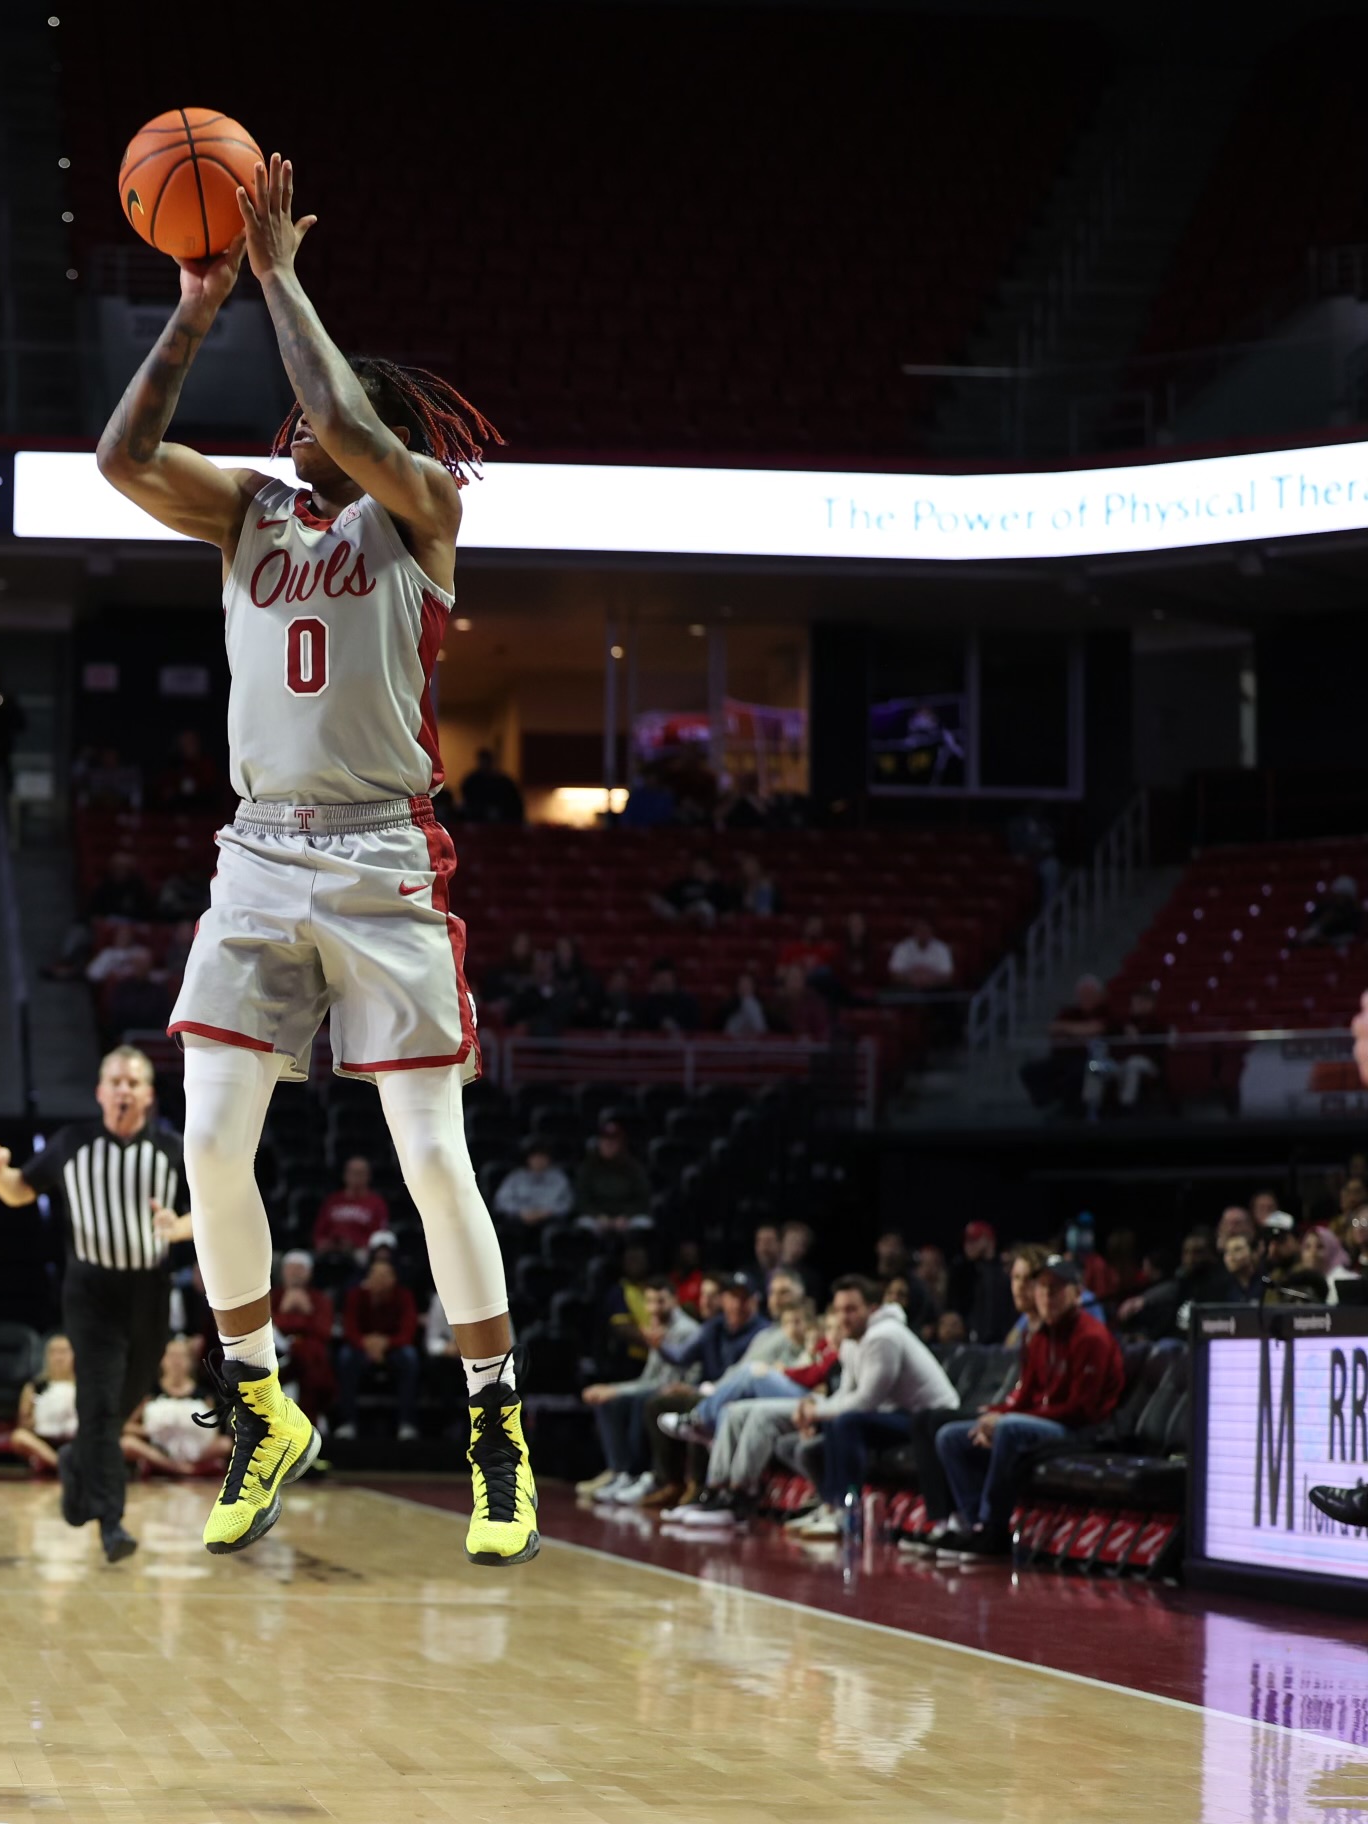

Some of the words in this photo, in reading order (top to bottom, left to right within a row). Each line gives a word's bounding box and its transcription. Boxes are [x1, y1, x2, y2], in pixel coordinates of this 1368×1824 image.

[824, 497, 895, 529] The
[913, 500, 1036, 533] Power
[1051, 497, 1091, 530] of
[1105, 479, 1256, 531] Physical
[250, 540, 377, 608] Owls
[284, 616, 330, 697] 0
[293, 809, 316, 833] T
